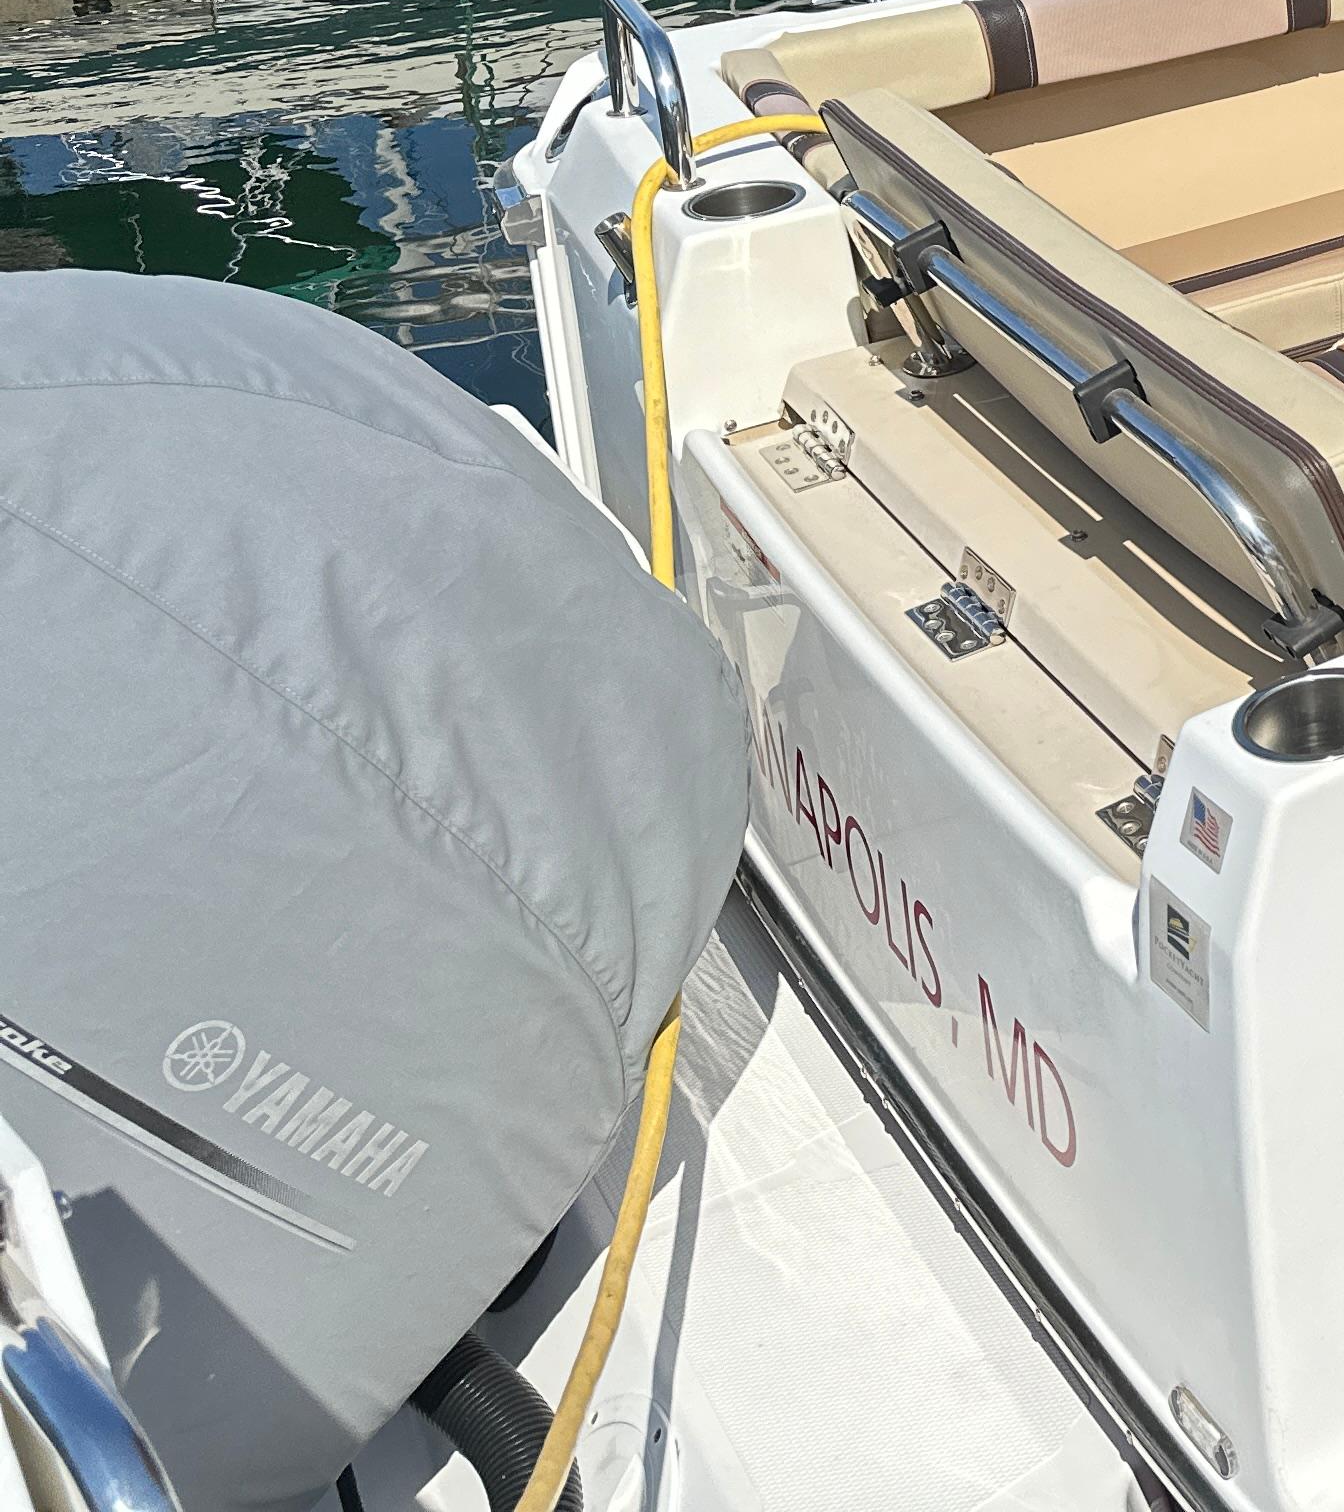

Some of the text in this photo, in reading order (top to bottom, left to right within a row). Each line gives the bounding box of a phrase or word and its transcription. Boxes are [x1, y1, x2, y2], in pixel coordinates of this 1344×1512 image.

[0, 1021, 72, 1075] oke
[979, 973, 1077, 1169] MD
[222, 1050, 430, 1197] YAMAHA
